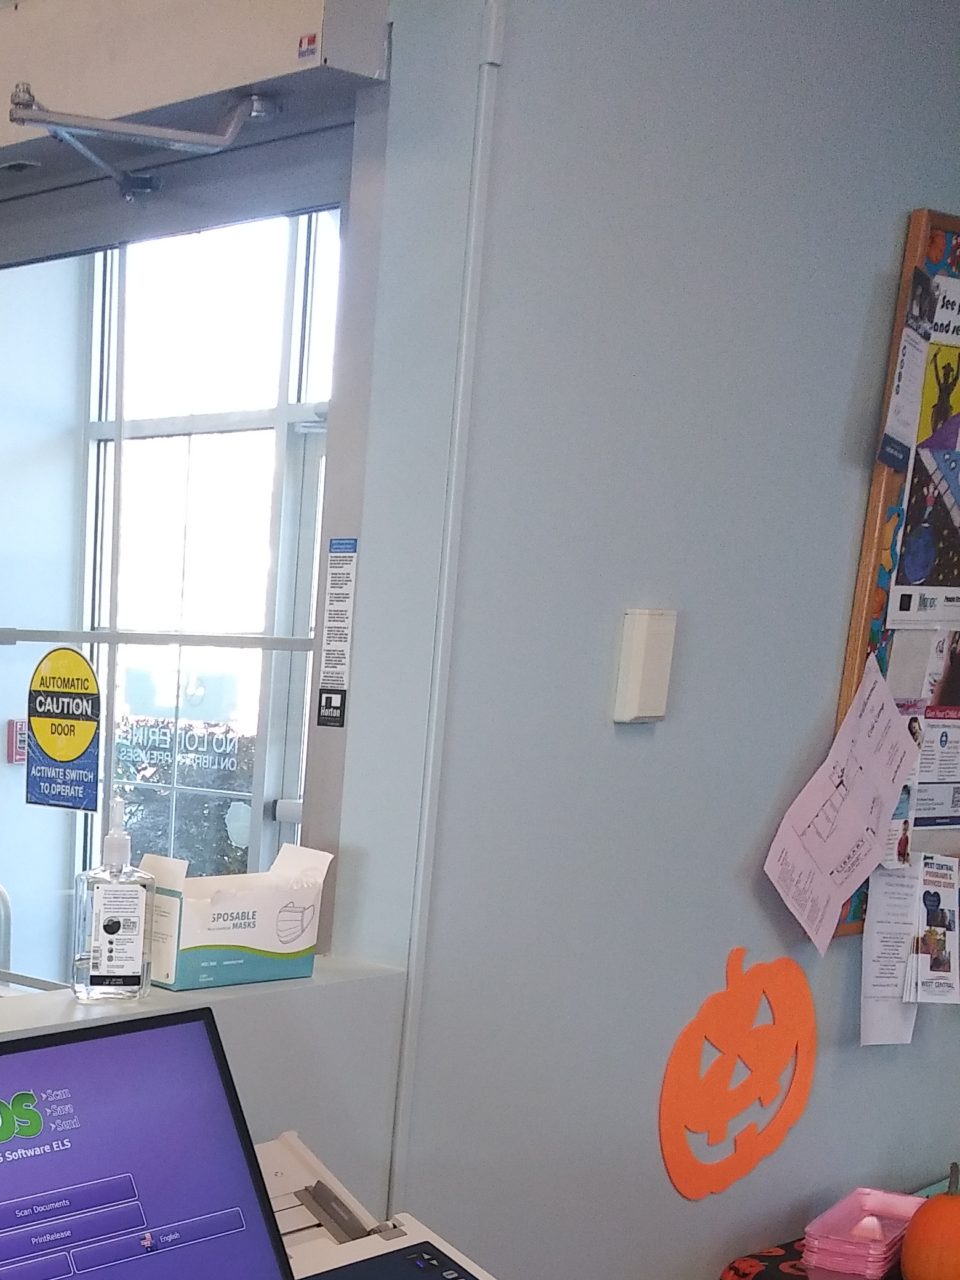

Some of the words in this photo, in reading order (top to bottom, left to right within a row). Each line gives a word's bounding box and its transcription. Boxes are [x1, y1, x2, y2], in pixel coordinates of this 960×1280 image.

[933, 320, 951, 334] and
[39, 675, 90, 691] AUTOMATIC
[35, 695, 93, 716] CAUTION
[50, 722, 76, 737] DOOR
[31, 765, 64, 779] ACTIVATE
[65, 768, 94, 783] SWITCH
[40, 783, 50, 794] TO
[51, 784, 84, 798] OPERATE
[231, 920, 256, 930] MASKS
[46, 1088, 71, 1101] Scan
[50, 1103, 75, 1117] Save
[54, 1115, 81, 1132] Send
[4, 1142, 52, 1162] Software
[52, 1138, 72, 1152] ELS
[15, 1207, 33, 1218] Scan
[33, 1198, 70, 1213] Documents
[31, 1229, 72, 1246] PrintRelease
[159, 1231, 181, 1244] English
